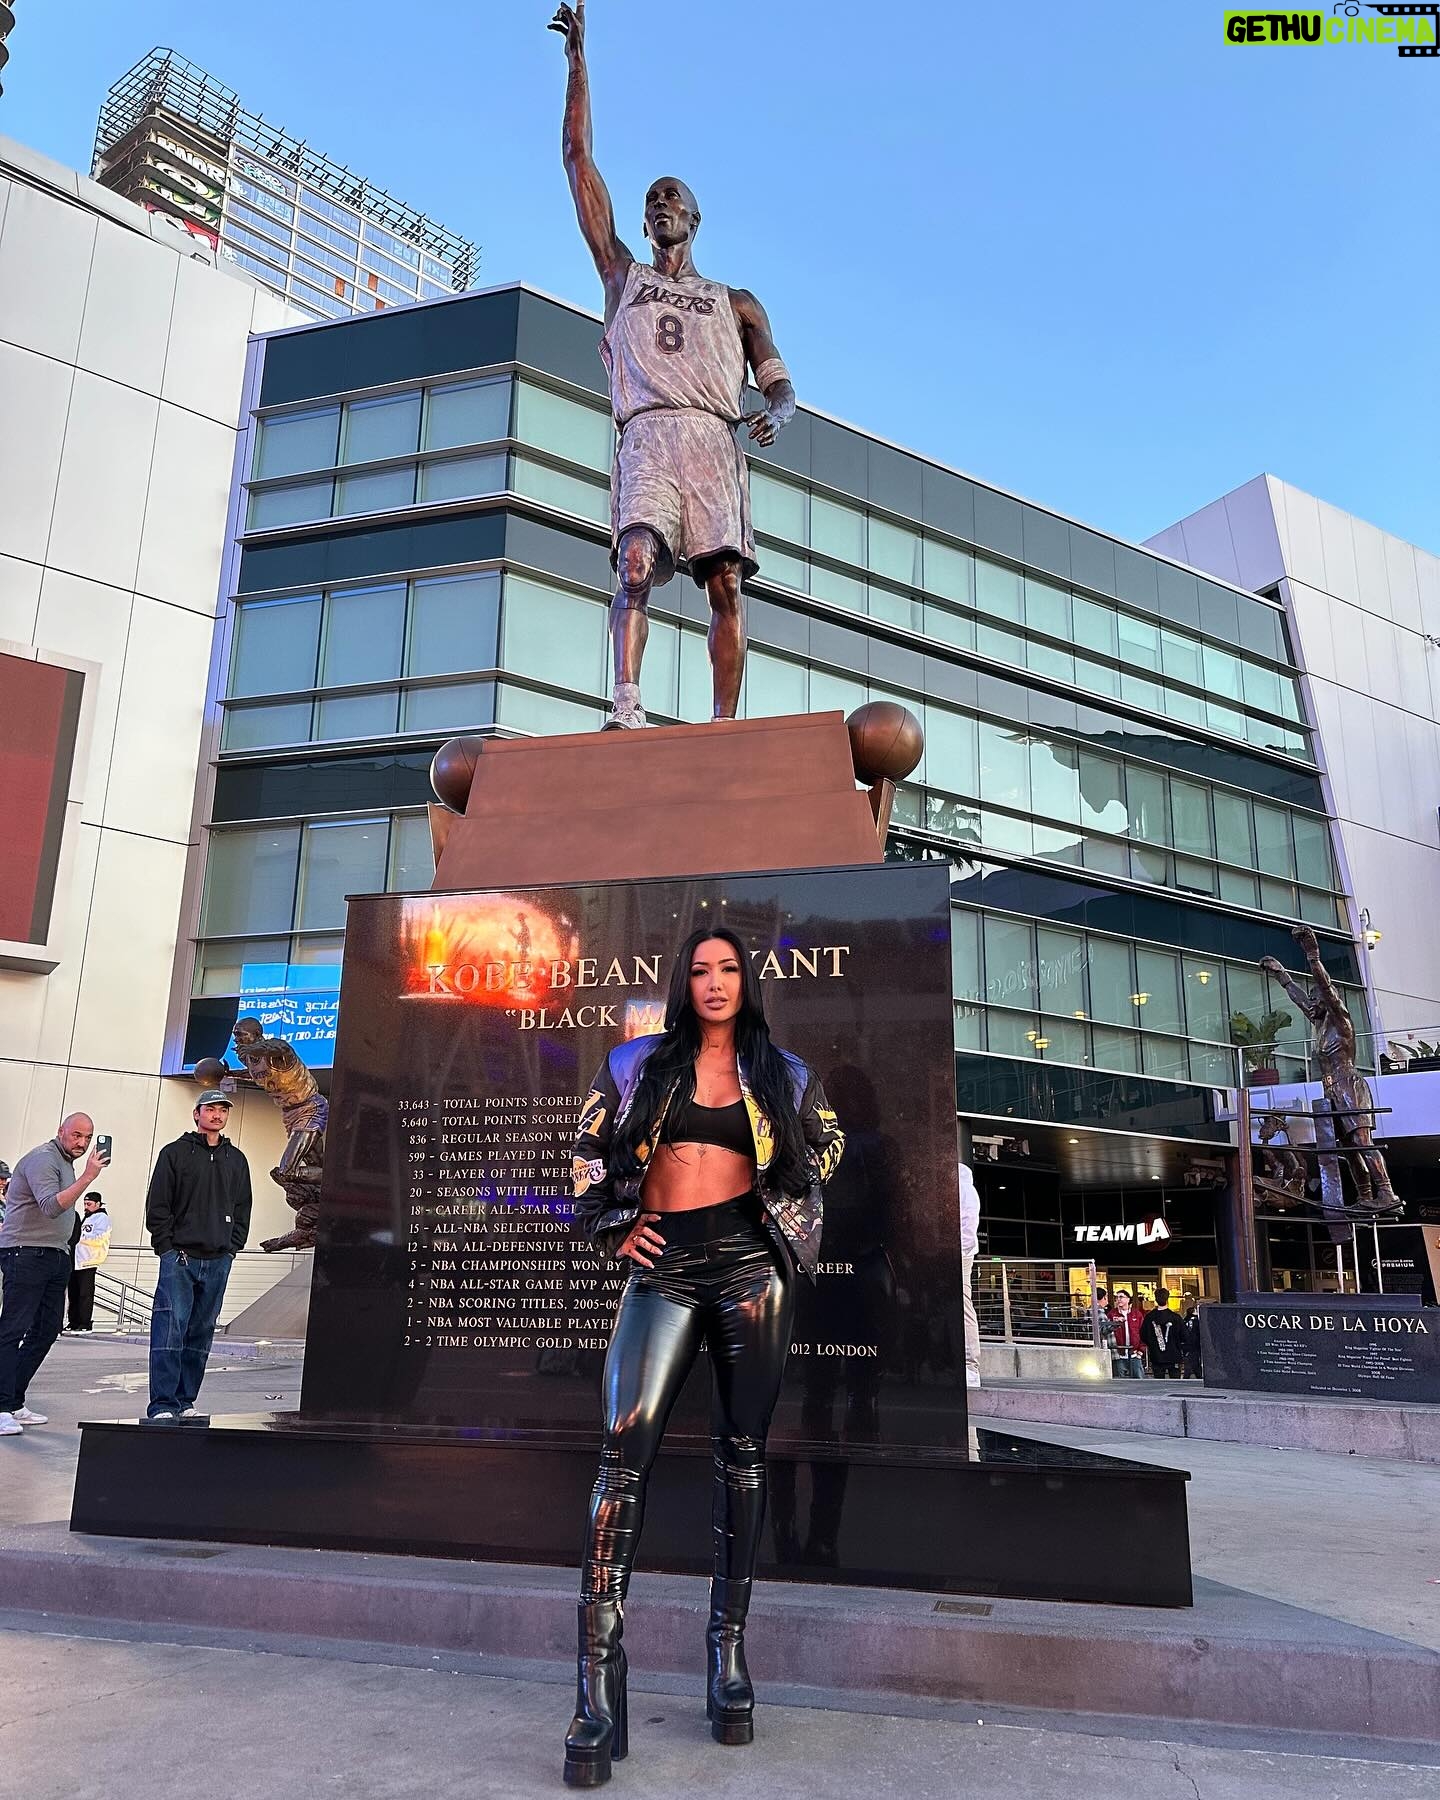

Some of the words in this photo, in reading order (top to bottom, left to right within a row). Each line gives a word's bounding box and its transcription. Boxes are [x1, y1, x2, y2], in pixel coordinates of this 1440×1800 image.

[627, 283, 716, 315] LAKERS
[656, 313, 684, 354] 8
[428, 962, 534, 994] KOBE
[549, 954, 663, 989] BEAN
[750, 946, 850, 980] ANT
[443, 1098, 481, 1109] TOTAL
[485, 1097, 528, 1108] POINTS
[532, 1095, 583, 1107] SCORED
[441, 1115, 480, 1127] TOTAL
[484, 1114, 527, 1126] POINTS
[531, 1113, 581, 1126] SCORED
[409, 1134, 427, 1145] 836
[441, 1132, 500, 1144] REGULAR
[505, 1131, 553, 1143] SEASON
[557, 1131, 578, 1142] WI
[408, 1152, 426, 1163] 599
[439, 1150, 483, 1162] GAMES
[487, 1150, 536, 1161] PLAYED
[541, 1149, 555, 1160] IN
[412, 1169, 425, 1180] 33
[439, 1168, 486, 1180] PLAYER
[490, 1168, 507, 1179] OF
[510, 1167, 536, 1178] THE
[409, 1187, 422, 1198] 20
[436, 1186, 491, 1197] SEASONS
[495, 1186, 528, 1196] WITH
[532, 1185, 558, 1196] THE
[410, 1205, 422, 1216] 18
[435, 1203, 487, 1215] CAREER
[489, 1204, 550, 1215] ALL-STAR
[409, 1223, 420, 1234] 15
[433, 1222, 488, 1234] ALL-NBA
[493, 1222, 570, 1233] SELECTIONS
[1074, 1225, 1135, 1242] TEAM
[1136, 1217, 1171, 1246] LA
[407, 1241, 418, 1252] 12
[433, 1241, 458, 1252] NBA
[462, 1241, 564, 1252] ALL-DEFENSIVE
[569, 1241, 593, 1252] TEA
[410, 1260, 417, 1271] 5
[431, 1260, 457, 1271] NBA
[461, 1259, 566, 1271] CHAMPIONSHIPS
[571, 1260, 600, 1271] WON
[606, 1260, 623, 1271] BY
[797, 1262, 855, 1275] CREER
[408, 1279, 415, 1289] 4
[430, 1278, 455, 1290] NBA
[460, 1278, 521, 1290] ALL-STAR
[525, 1278, 563, 1290] GAME
[569, 1279, 598, 1290] MVP
[601, 1279, 626, 1291] AWA
[407, 1297, 414, 1308] 2
[428, 1297, 454, 1309] NBA
[458, 1297, 516, 1309] SCORING
[573, 1298, 618, 1311] 2005-06
[407, 1316, 412, 1327] 1
[427, 1316, 453, 1328] NBA
[457, 1316, 492, 1328] MOST
[495, 1317, 562, 1329] VALUABLE
[1244, 1313, 1303, 1330] OSCAR
[1310, 1316, 1335, 1331] DE
[1342, 1316, 1367, 1332] LA
[1374, 1317, 1429, 1334] HOYA
[403, 1335, 410, 1346] 2
[425, 1335, 432, 1347] 2
[436, 1335, 469, 1347] TIME
[473, 1336, 531, 1348] OLYMPIC
[535, 1337, 573, 1349] GOLD
[577, 1337, 608, 1350] MED
[789, 1343, 811, 1356] 012
[817, 1344, 878, 1357] LONDON
